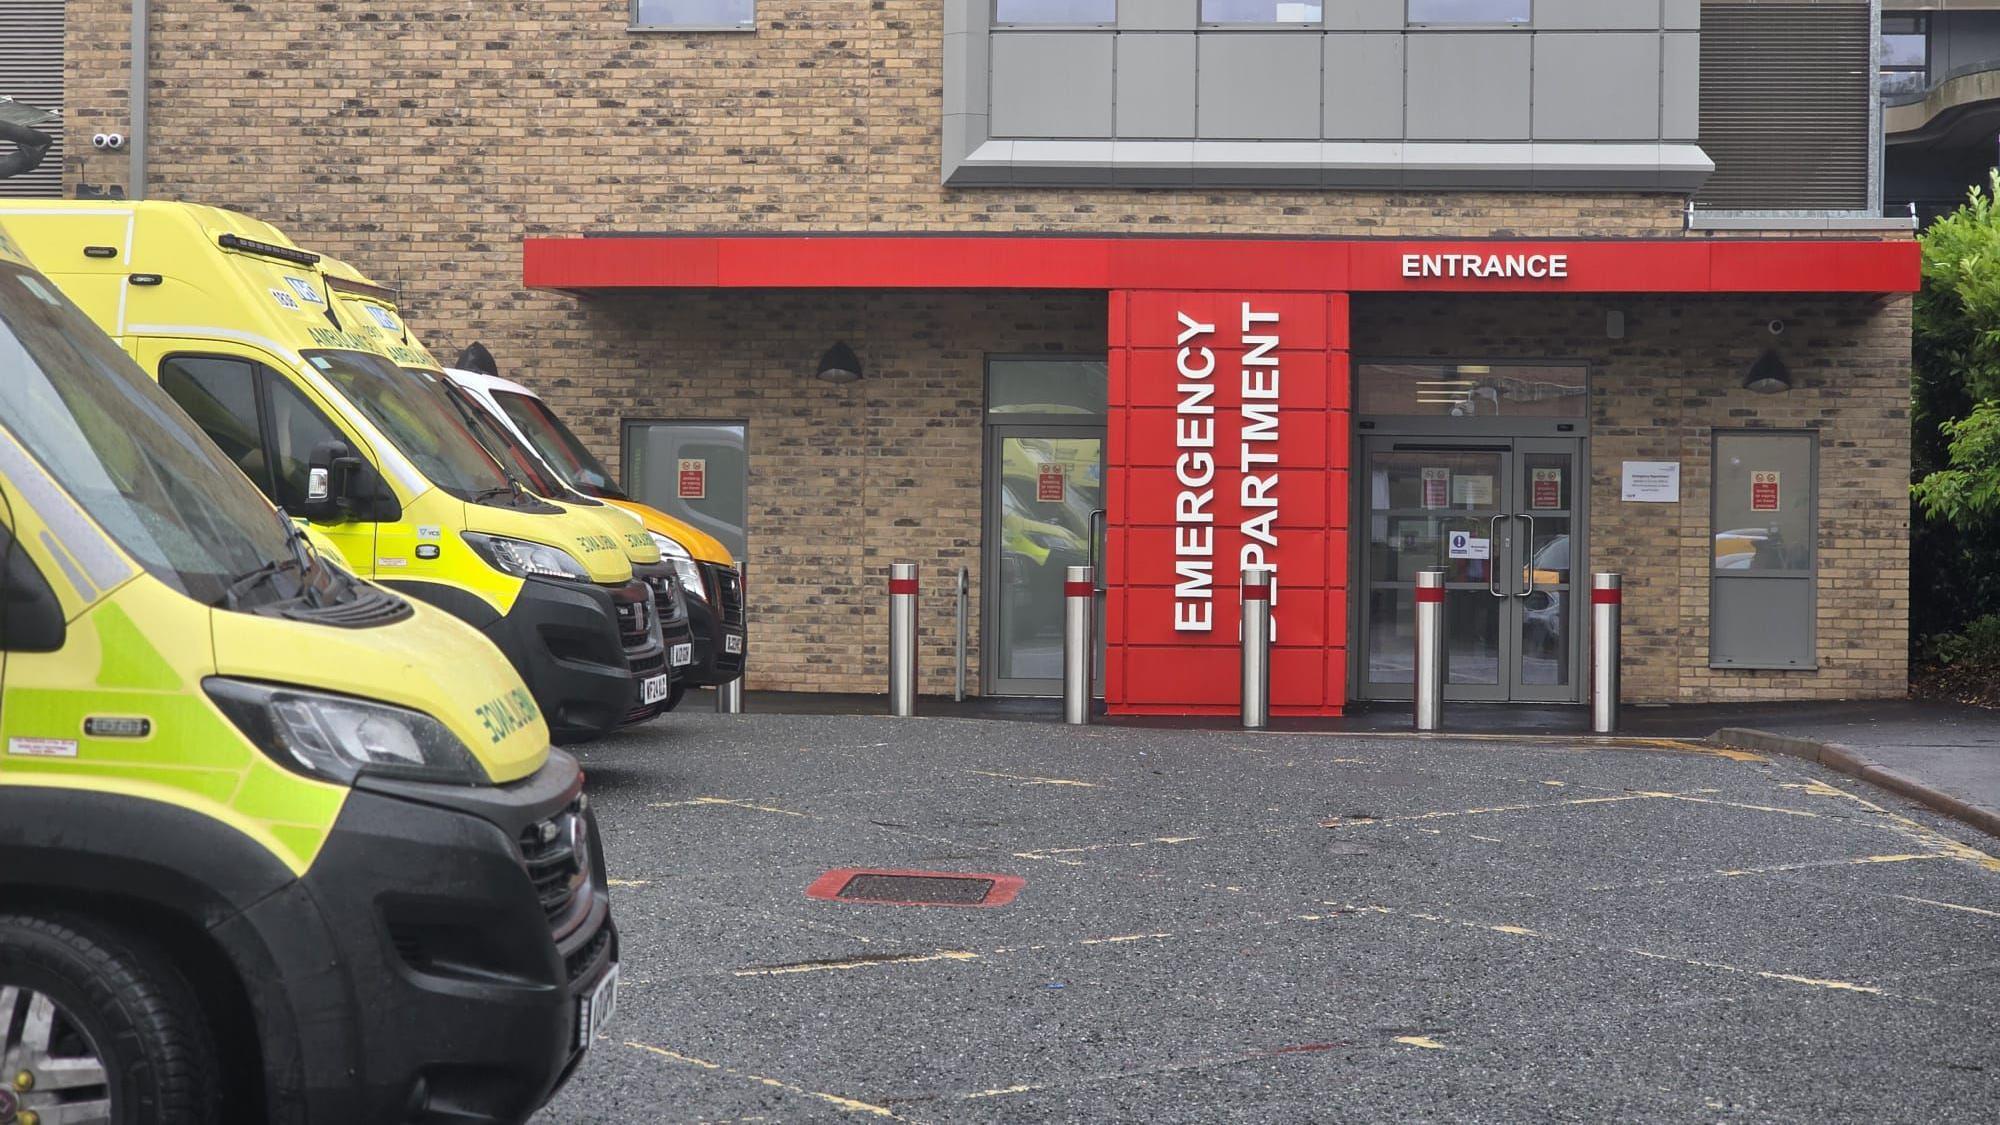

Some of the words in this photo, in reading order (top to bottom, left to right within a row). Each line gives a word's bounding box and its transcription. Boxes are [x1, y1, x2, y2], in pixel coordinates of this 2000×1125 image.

[1402, 254, 1568, 278] ENTRANCE
[1175, 311, 1215, 631] EMERGENCY
[1239, 302, 1279, 642] PARTMENT
